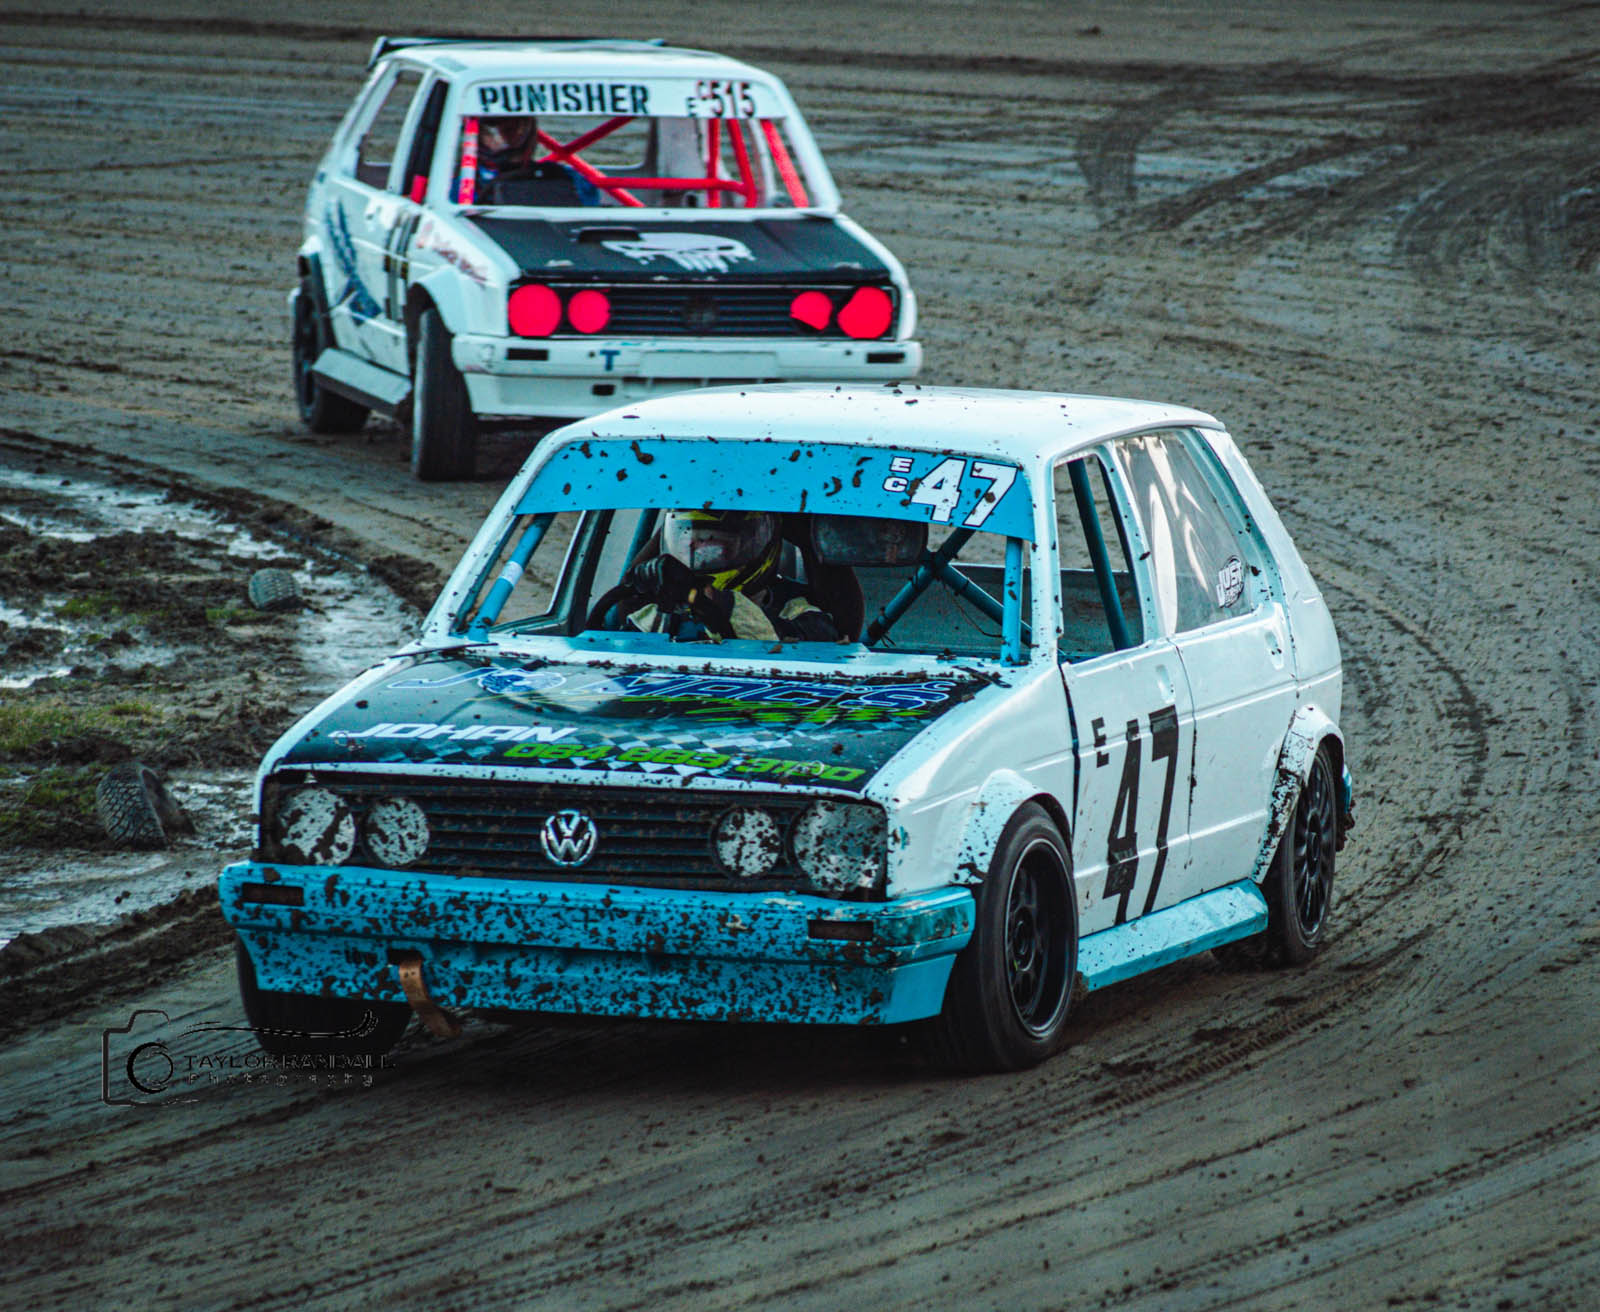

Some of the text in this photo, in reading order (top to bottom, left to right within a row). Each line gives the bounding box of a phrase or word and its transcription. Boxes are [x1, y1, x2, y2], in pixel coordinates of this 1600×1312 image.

[478, 82, 649, 114] PUNISHER
[709, 80, 757, 117] 515
[600, 350, 620, 370] T
[911, 457, 1018, 527] 47
[328, 723, 578, 742] JOHAN
[1102, 704, 1179, 926] 47
[541, 809, 597, 866] VW
